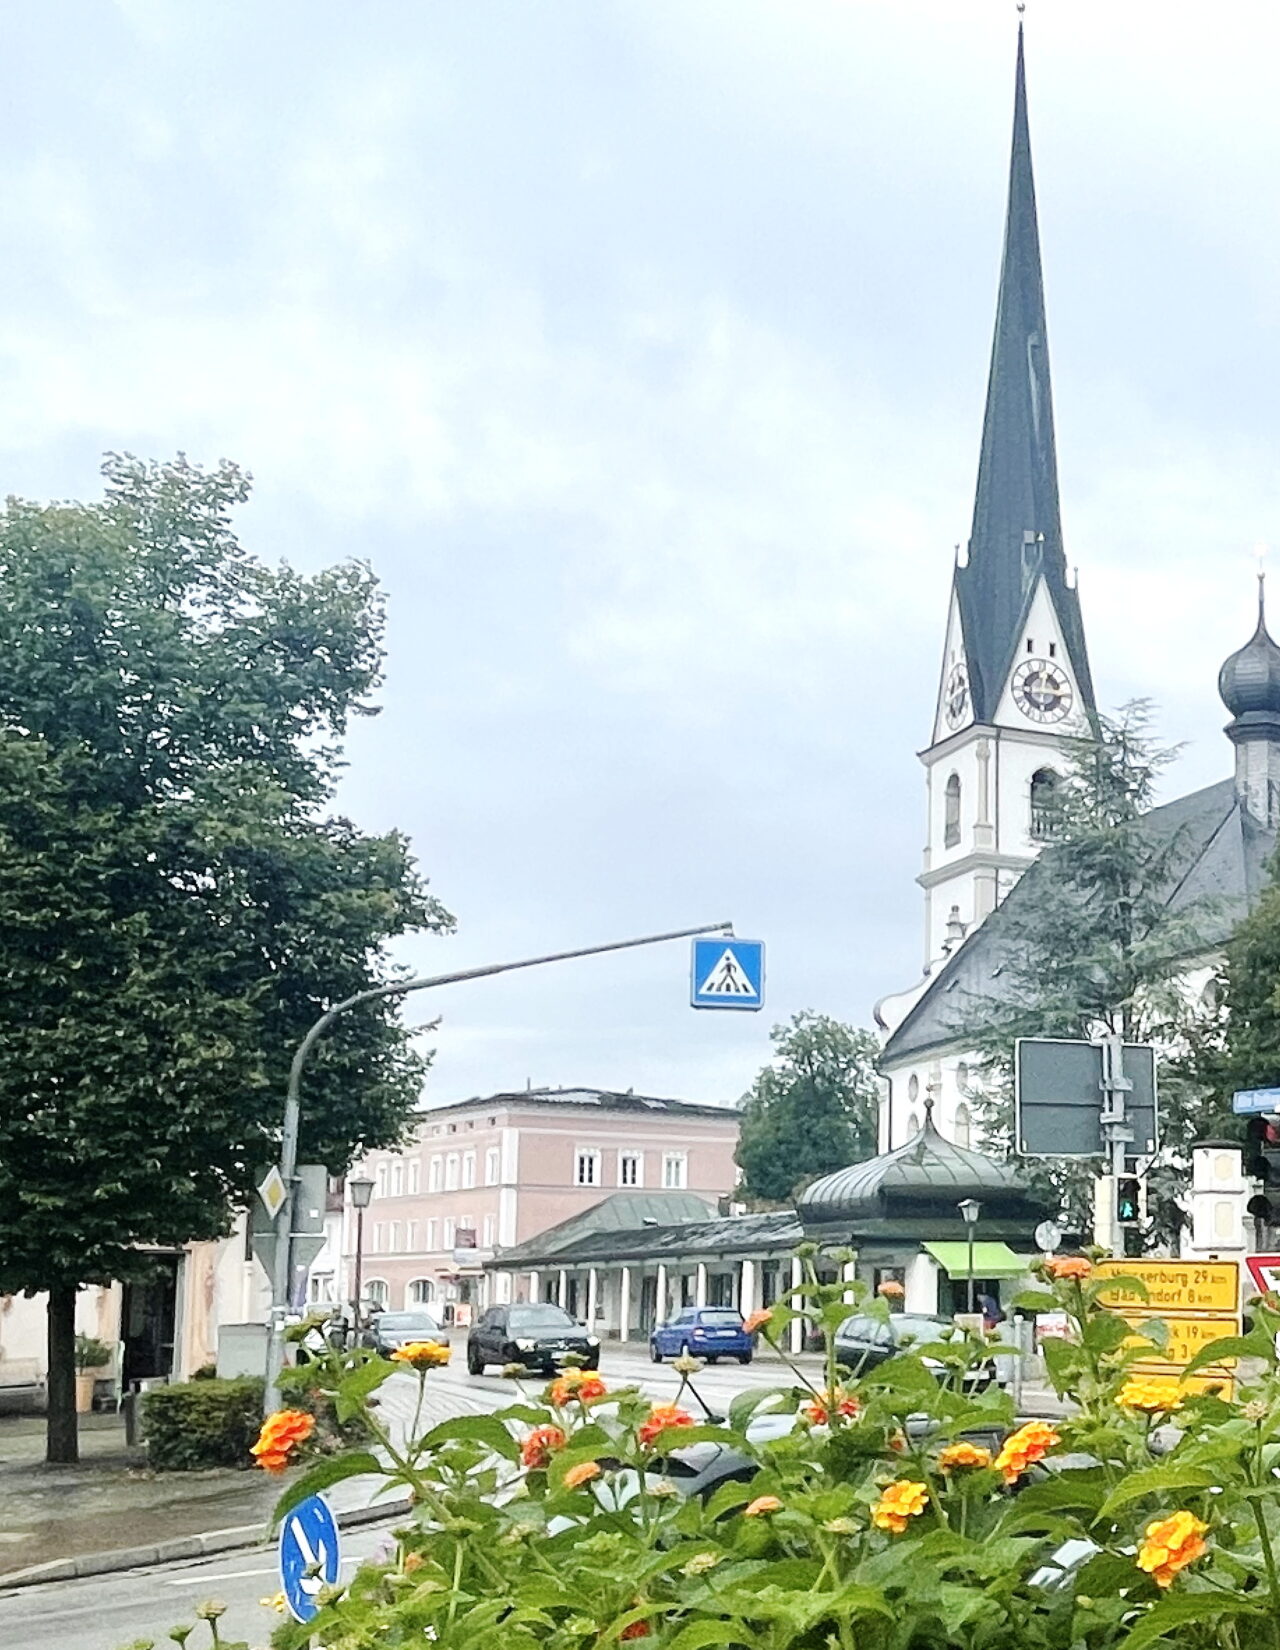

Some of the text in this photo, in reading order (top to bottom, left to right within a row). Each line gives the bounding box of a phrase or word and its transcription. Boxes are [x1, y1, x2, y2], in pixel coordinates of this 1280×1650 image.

[1194, 1270, 1208, 1284] 29
[1141, 1289, 1182, 1302] ndorf
[1186, 1326, 1198, 1339] 19
